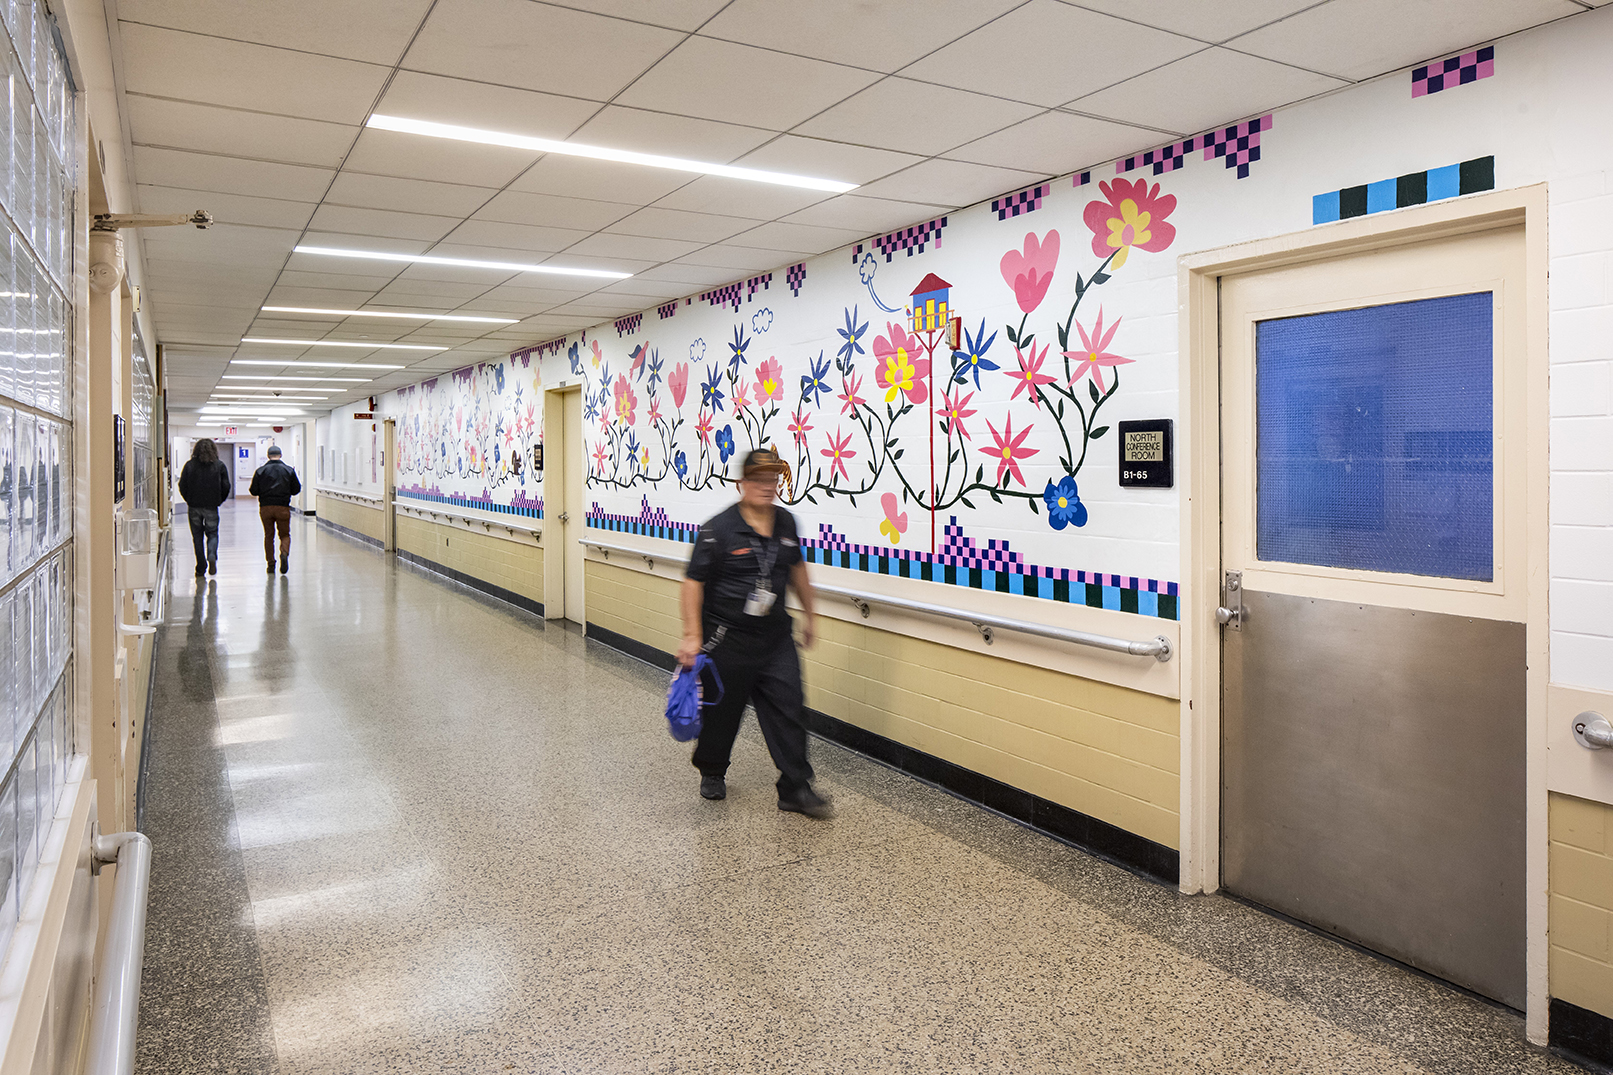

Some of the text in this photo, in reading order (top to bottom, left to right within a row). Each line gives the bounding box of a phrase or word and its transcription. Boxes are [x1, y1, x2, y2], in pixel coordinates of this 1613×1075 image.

[226, 426, 238, 435] EXIT
[1130, 434, 1156, 442] NORTH
[1126, 442, 1160, 451] CONFERENCE
[1131, 452, 1156, 460] ROOM
[1124, 470, 1148, 479] B1-65
